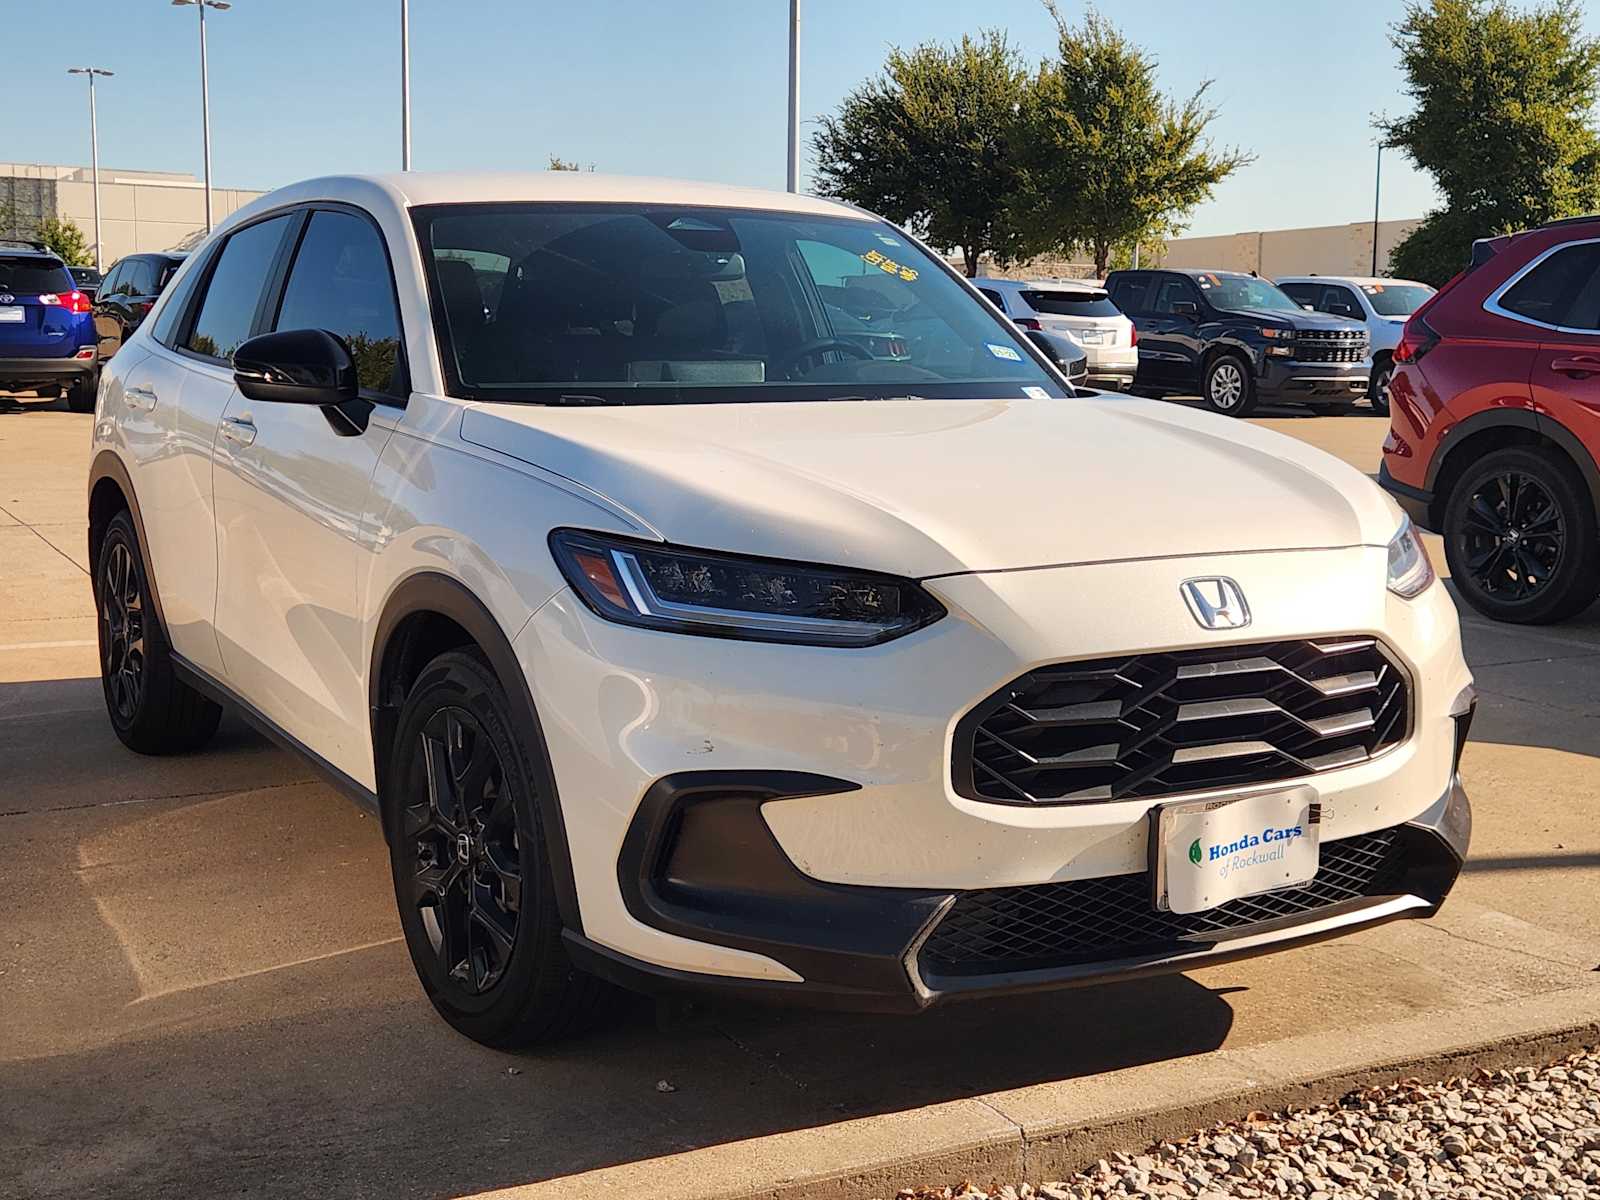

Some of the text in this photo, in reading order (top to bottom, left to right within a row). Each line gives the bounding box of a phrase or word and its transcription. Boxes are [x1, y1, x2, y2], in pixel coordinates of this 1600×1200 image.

[1209, 825, 1302, 861] Honda Cars
[1219, 845, 1284, 879] of Rockwall
